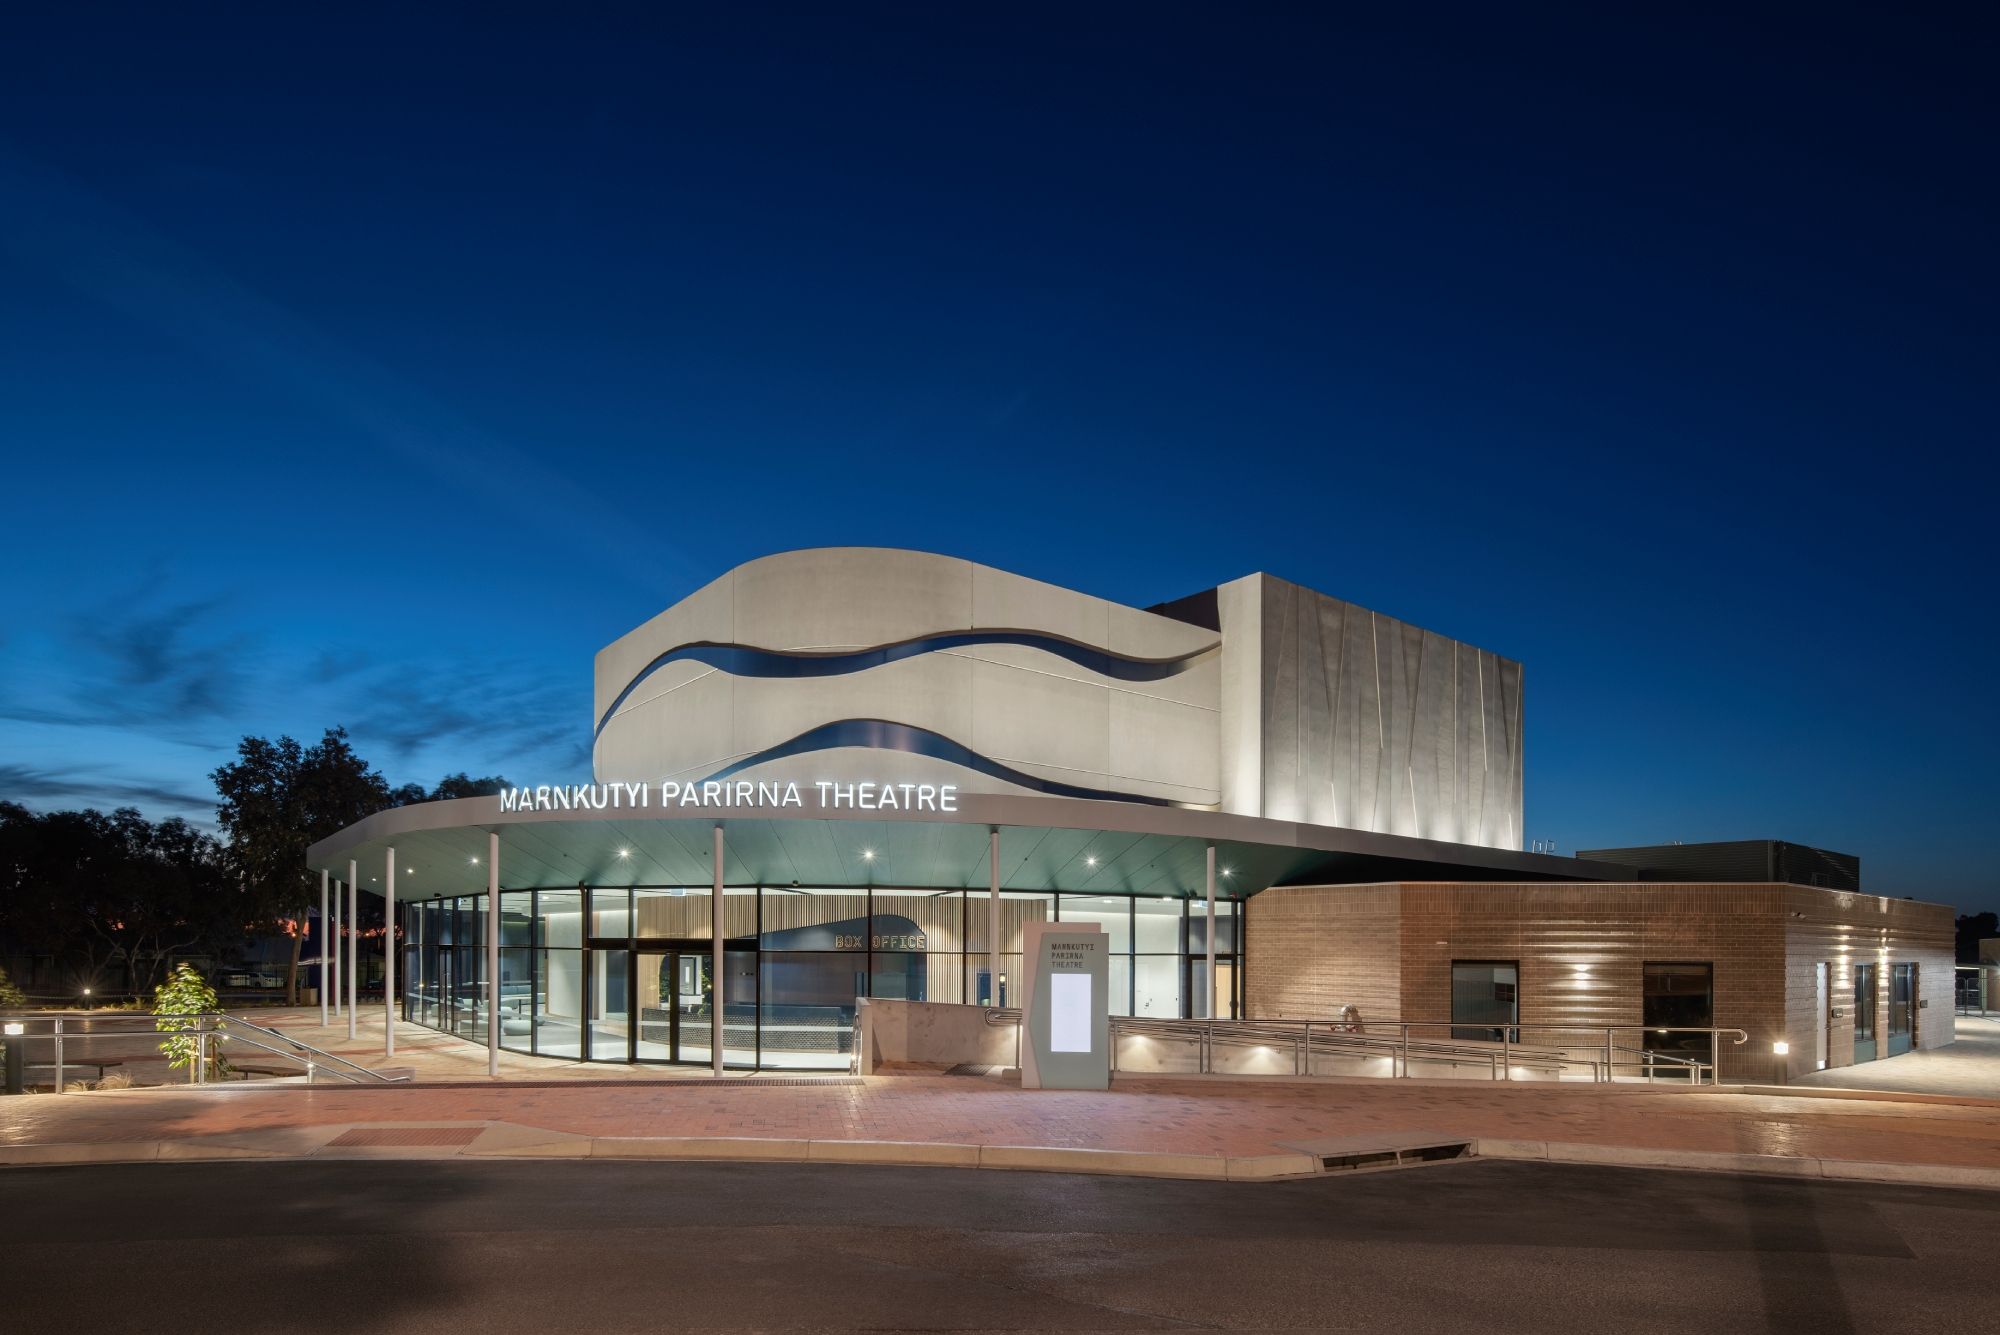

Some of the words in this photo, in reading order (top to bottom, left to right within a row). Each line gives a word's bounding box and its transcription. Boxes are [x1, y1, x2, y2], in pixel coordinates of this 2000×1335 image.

[499, 782, 649, 812] MARNKUTYI
[662, 781, 802, 810] PARIRNA
[815, 781, 958, 812] THEATRE
[835, 935, 863, 949] BOX
[872, 935, 925, 949] OFFICE
[1051, 943, 1095, 951] MARNKUTYI
[1051, 952, 1084, 960] PARIRNA
[1051, 961, 1084, 969] THEATRE
